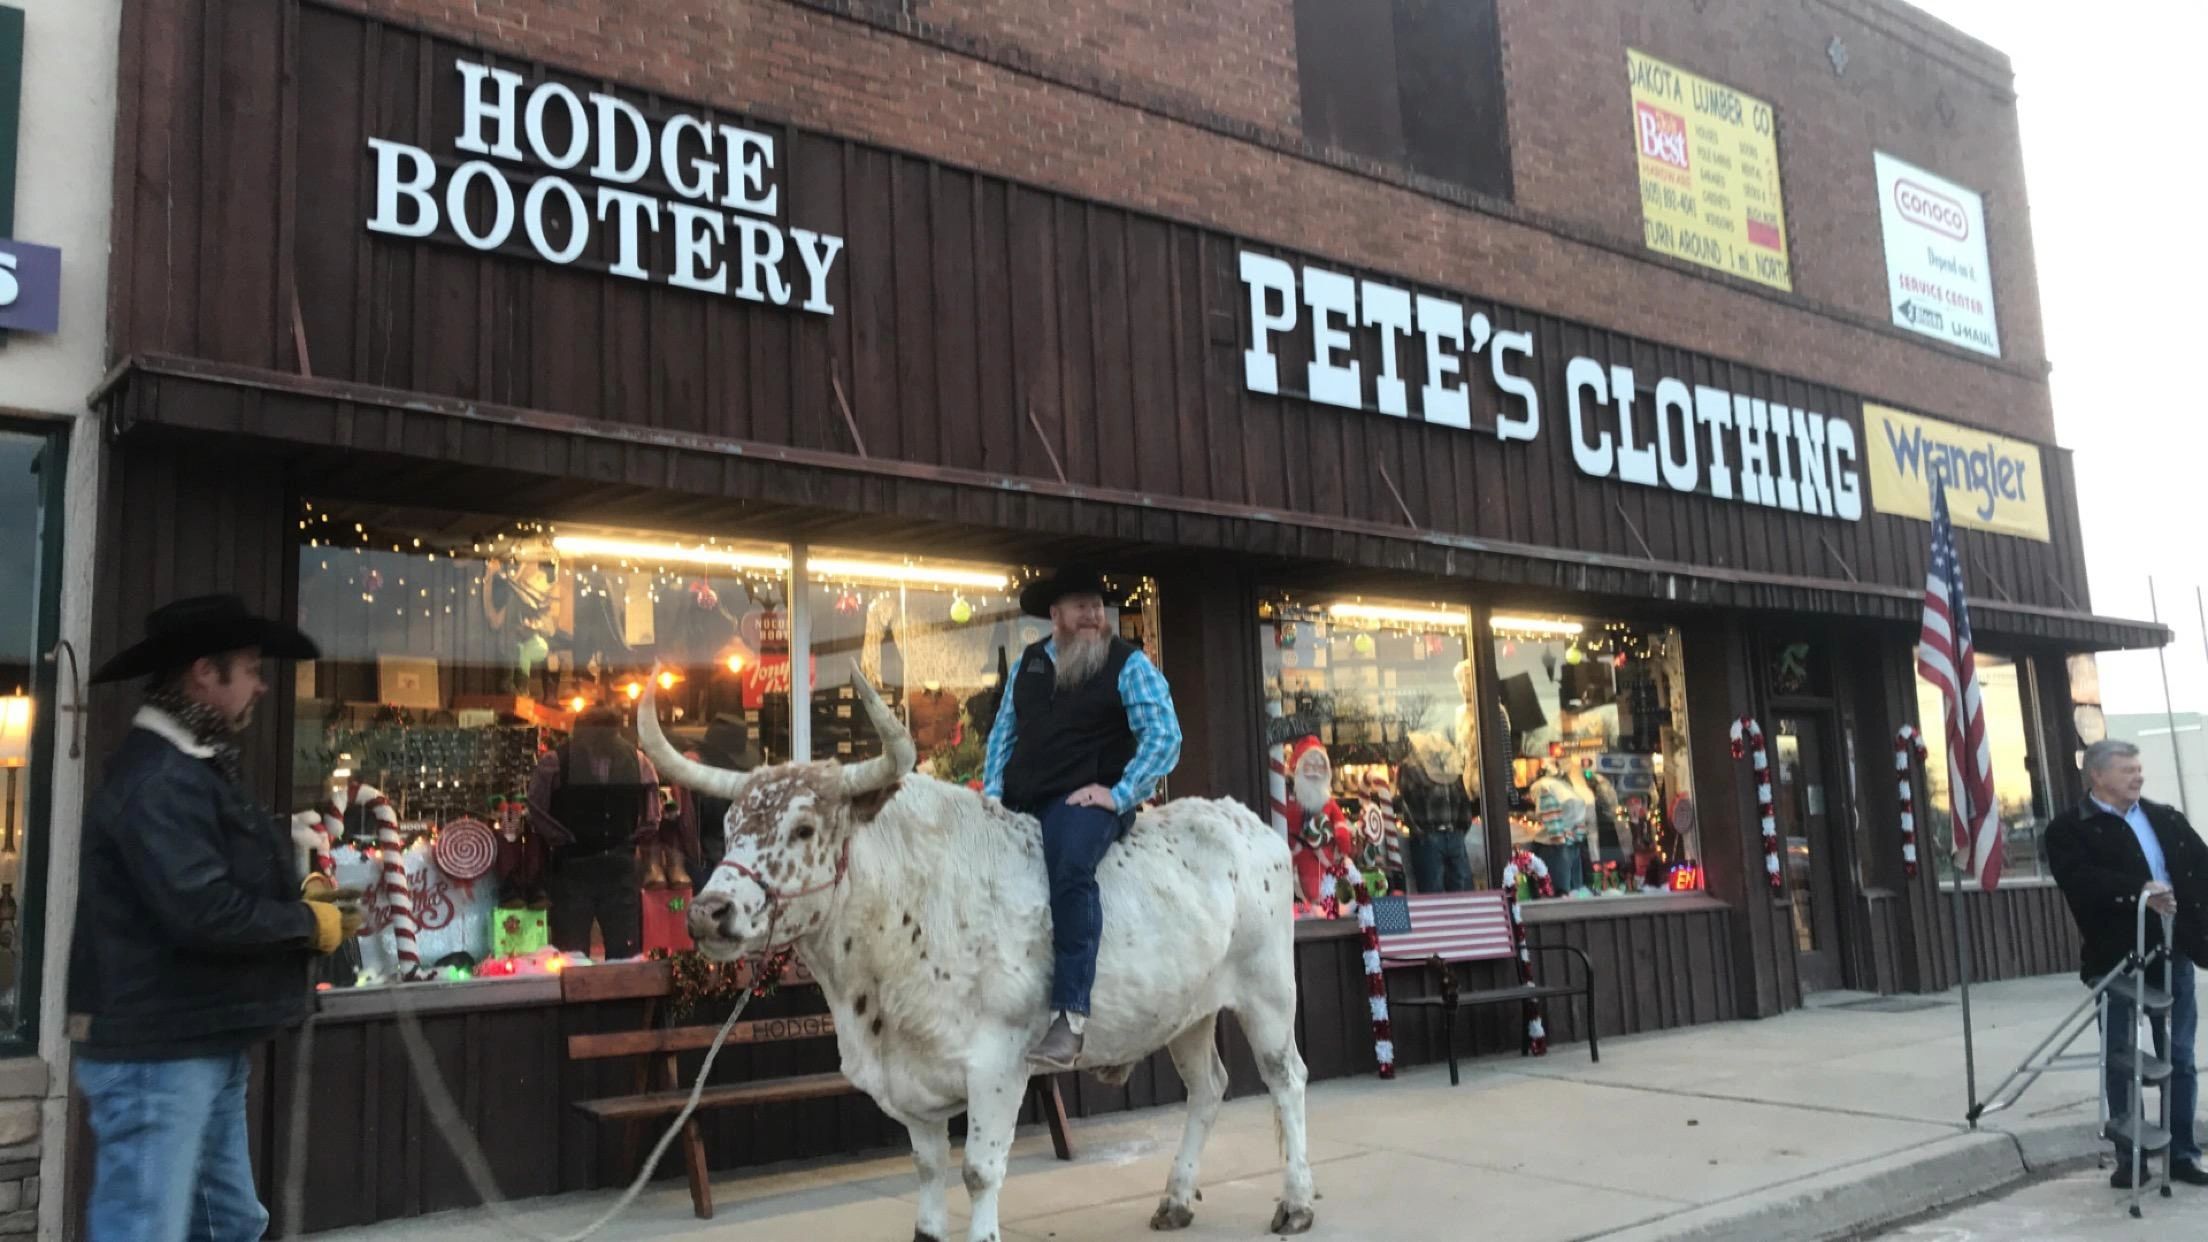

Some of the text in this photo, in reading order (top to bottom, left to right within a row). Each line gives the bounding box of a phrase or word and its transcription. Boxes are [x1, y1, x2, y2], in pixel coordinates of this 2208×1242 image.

[1627, 58, 1682, 104] DAKOTA
[1692, 79, 1744, 128] LUMBER
[455, 59, 778, 216] HODGE
[1639, 110, 1687, 168] Best
[366, 137, 844, 316] BOOTERY
[1645, 217, 1673, 251] TURN
[1679, 227, 1721, 264] AROUND
[1239, 250, 1862, 522] PETE'S CLOTHING
[1883, 418, 2027, 521] Wrangler
[752, 1016, 834, 1040] HODGE
